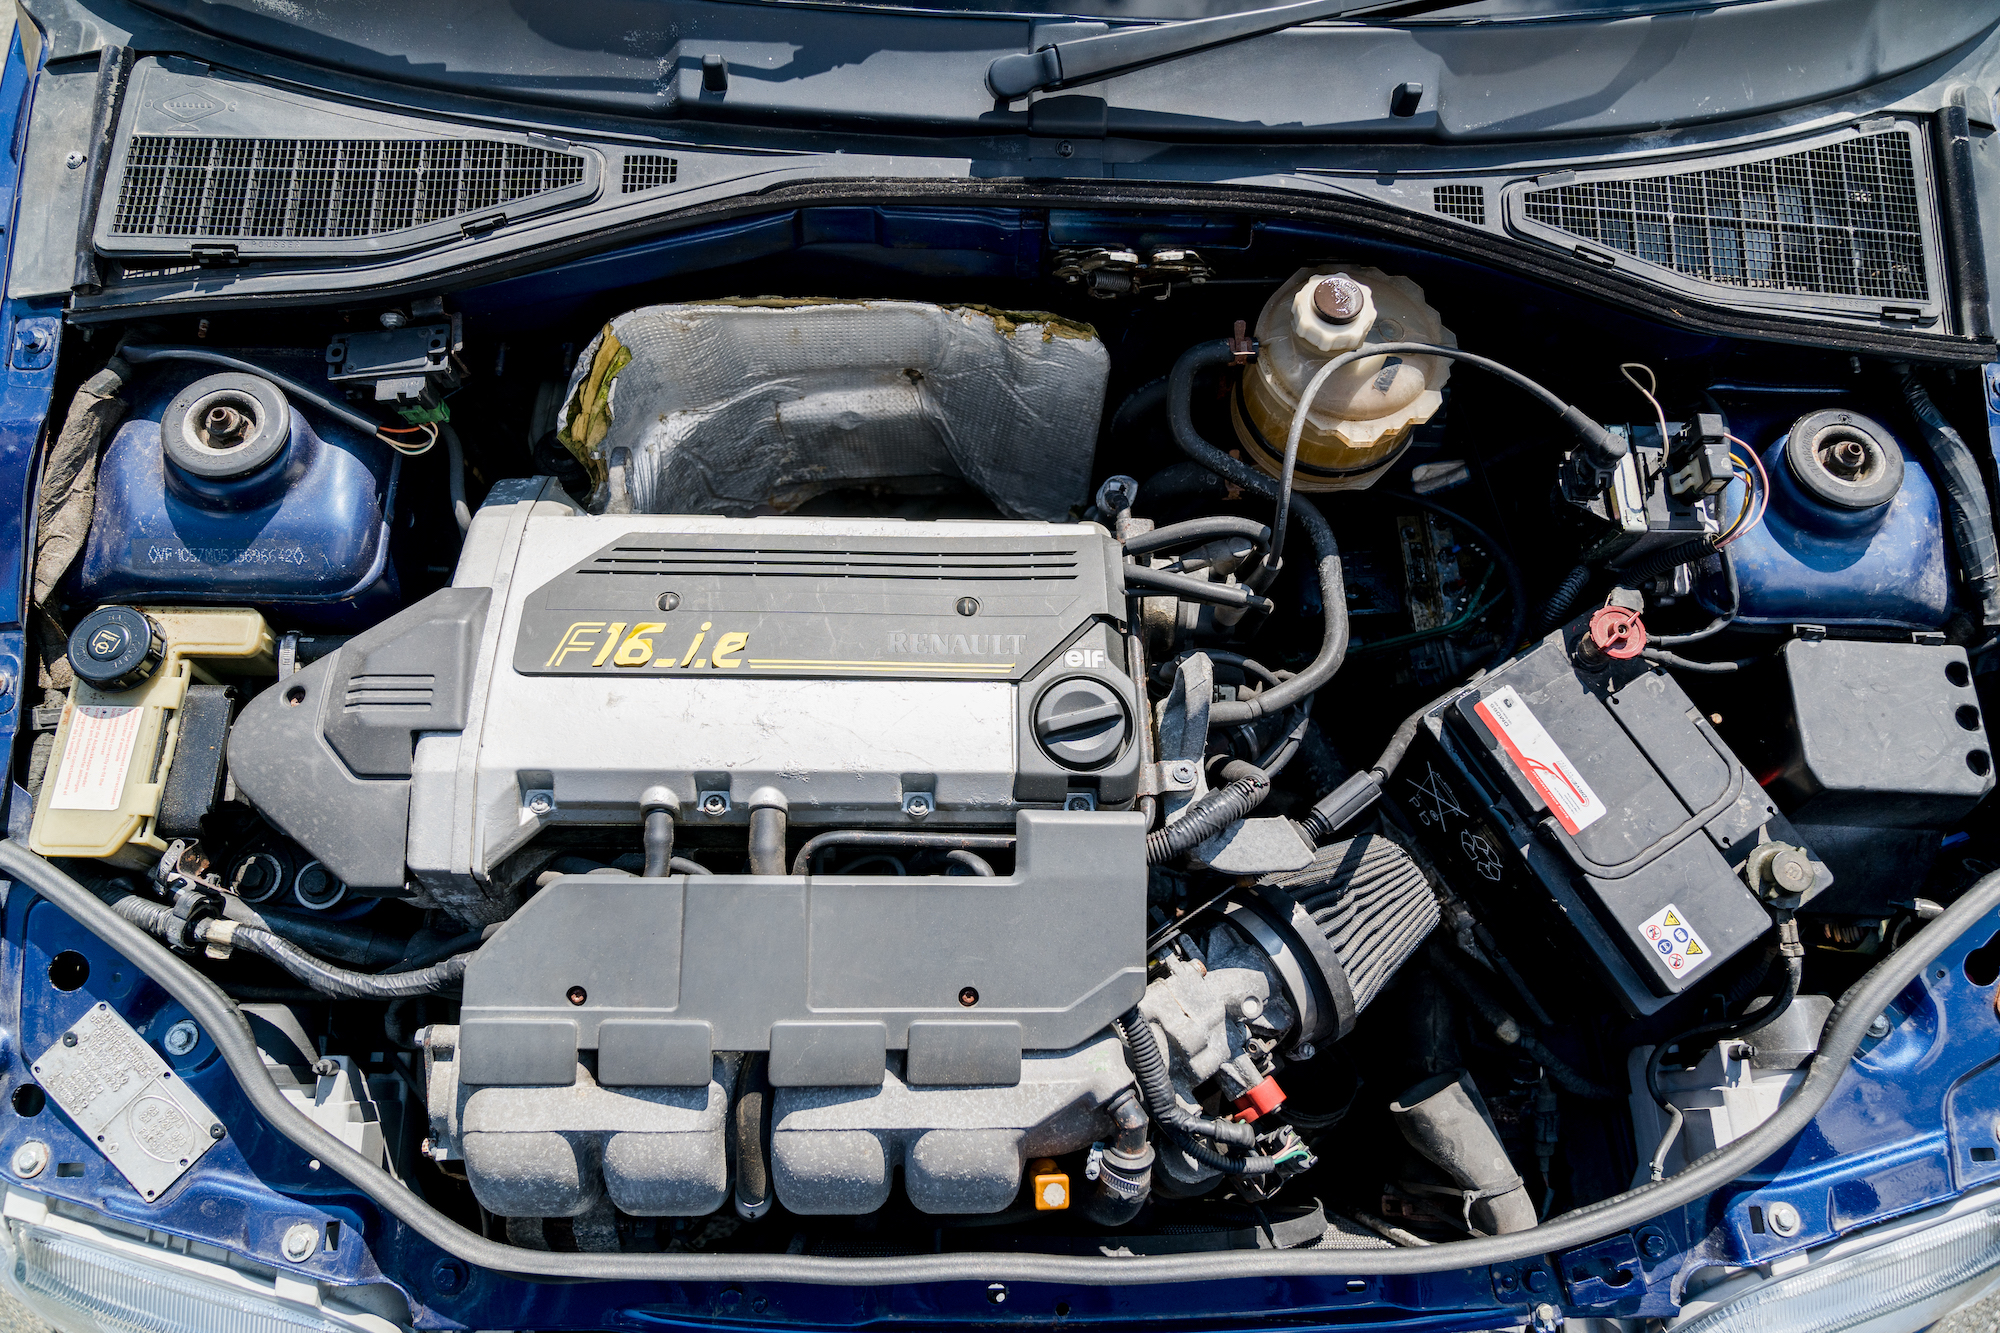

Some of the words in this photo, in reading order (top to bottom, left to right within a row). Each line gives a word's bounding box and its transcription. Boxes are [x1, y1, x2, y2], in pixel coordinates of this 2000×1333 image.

[887, 632, 1027, 655] RENAULT
[1065, 649, 1104, 668] elf
[103, 718, 113, 741] protective
[84, 739, 98, 770] Abdeckkappe
[99, 742, 107, 755] cover
[102, 744, 113, 764] correctly
[63, 755, 77, 789] correctamente
[72, 769, 84, 792] anbringen
[109, 773, 122, 804] correctement
[108, 1020, 131, 1042] REGIE
[119, 1047, 153, 1080] RENAULT
